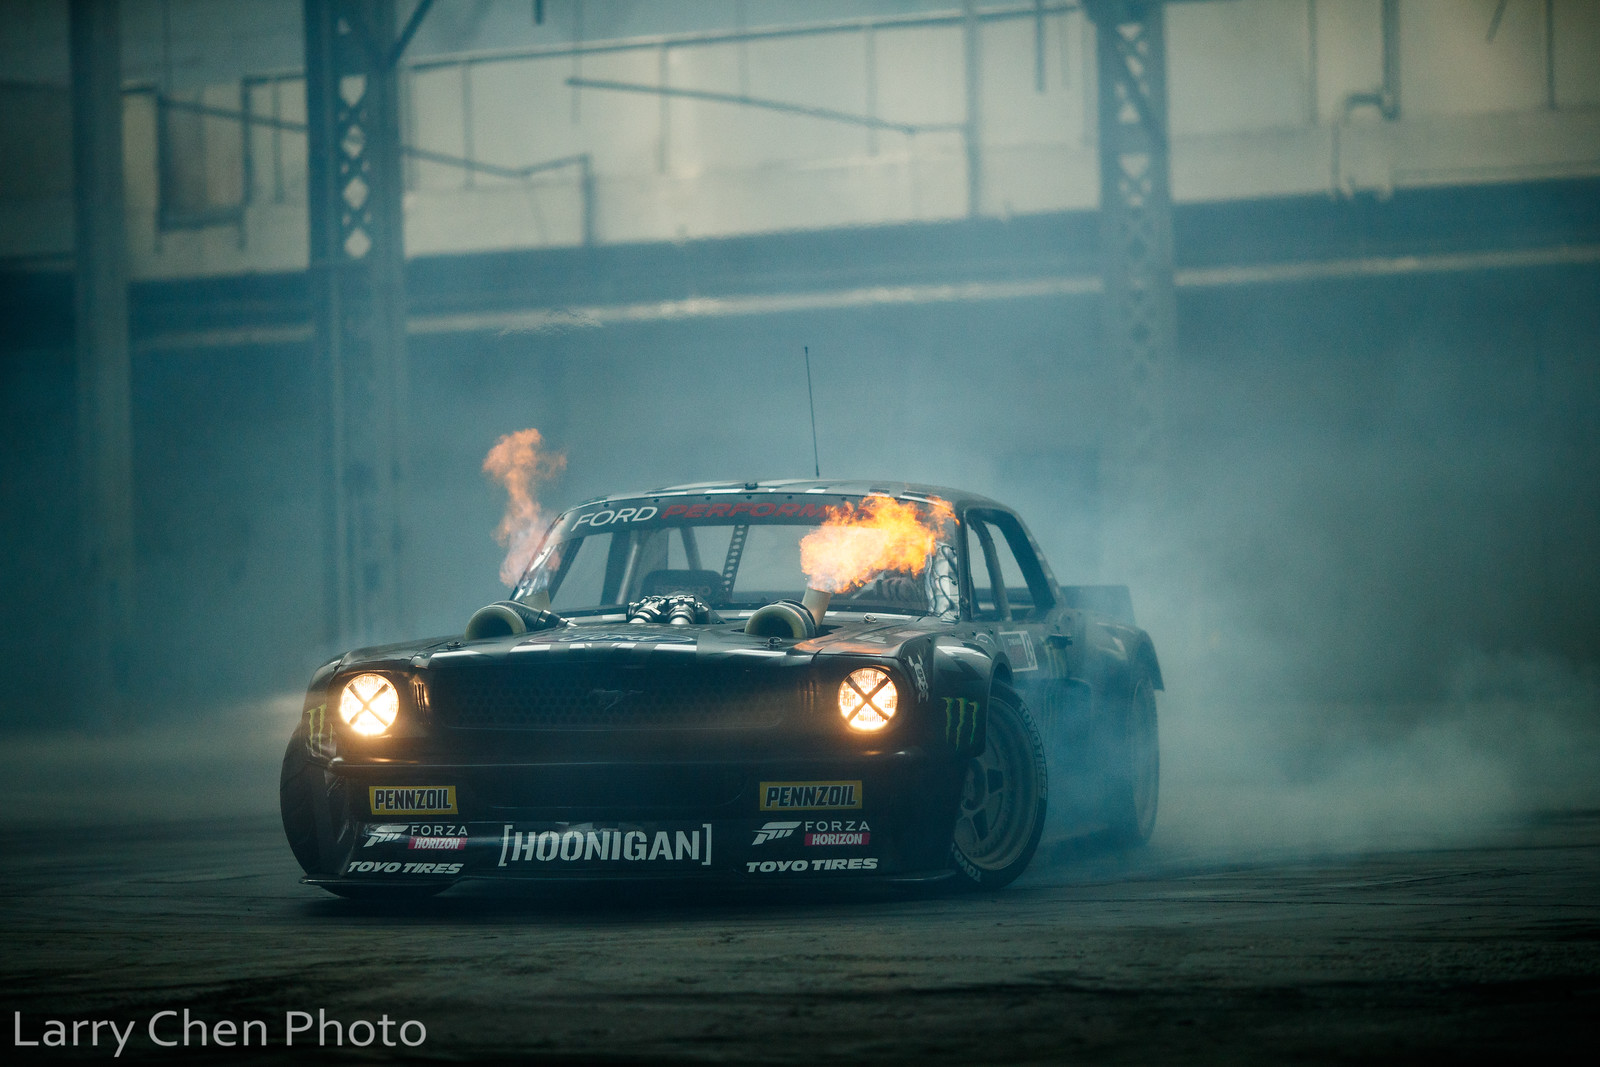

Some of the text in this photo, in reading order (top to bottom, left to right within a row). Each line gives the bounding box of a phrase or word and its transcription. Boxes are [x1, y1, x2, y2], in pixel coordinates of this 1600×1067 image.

[570, 502, 850, 532] FORD PERFORM
[373, 788, 452, 810] PENNZOIL
[765, 785, 857, 807] PENNZOIL
[410, 825, 468, 836] FORZA
[805, 821, 870, 831] FORZA
[413, 836, 460, 850] HORIZON
[812, 833, 863, 845] HORIZON
[347, 861, 465, 874] TOYO TIRES
[746, 858, 879, 873] TOYO TIRES
